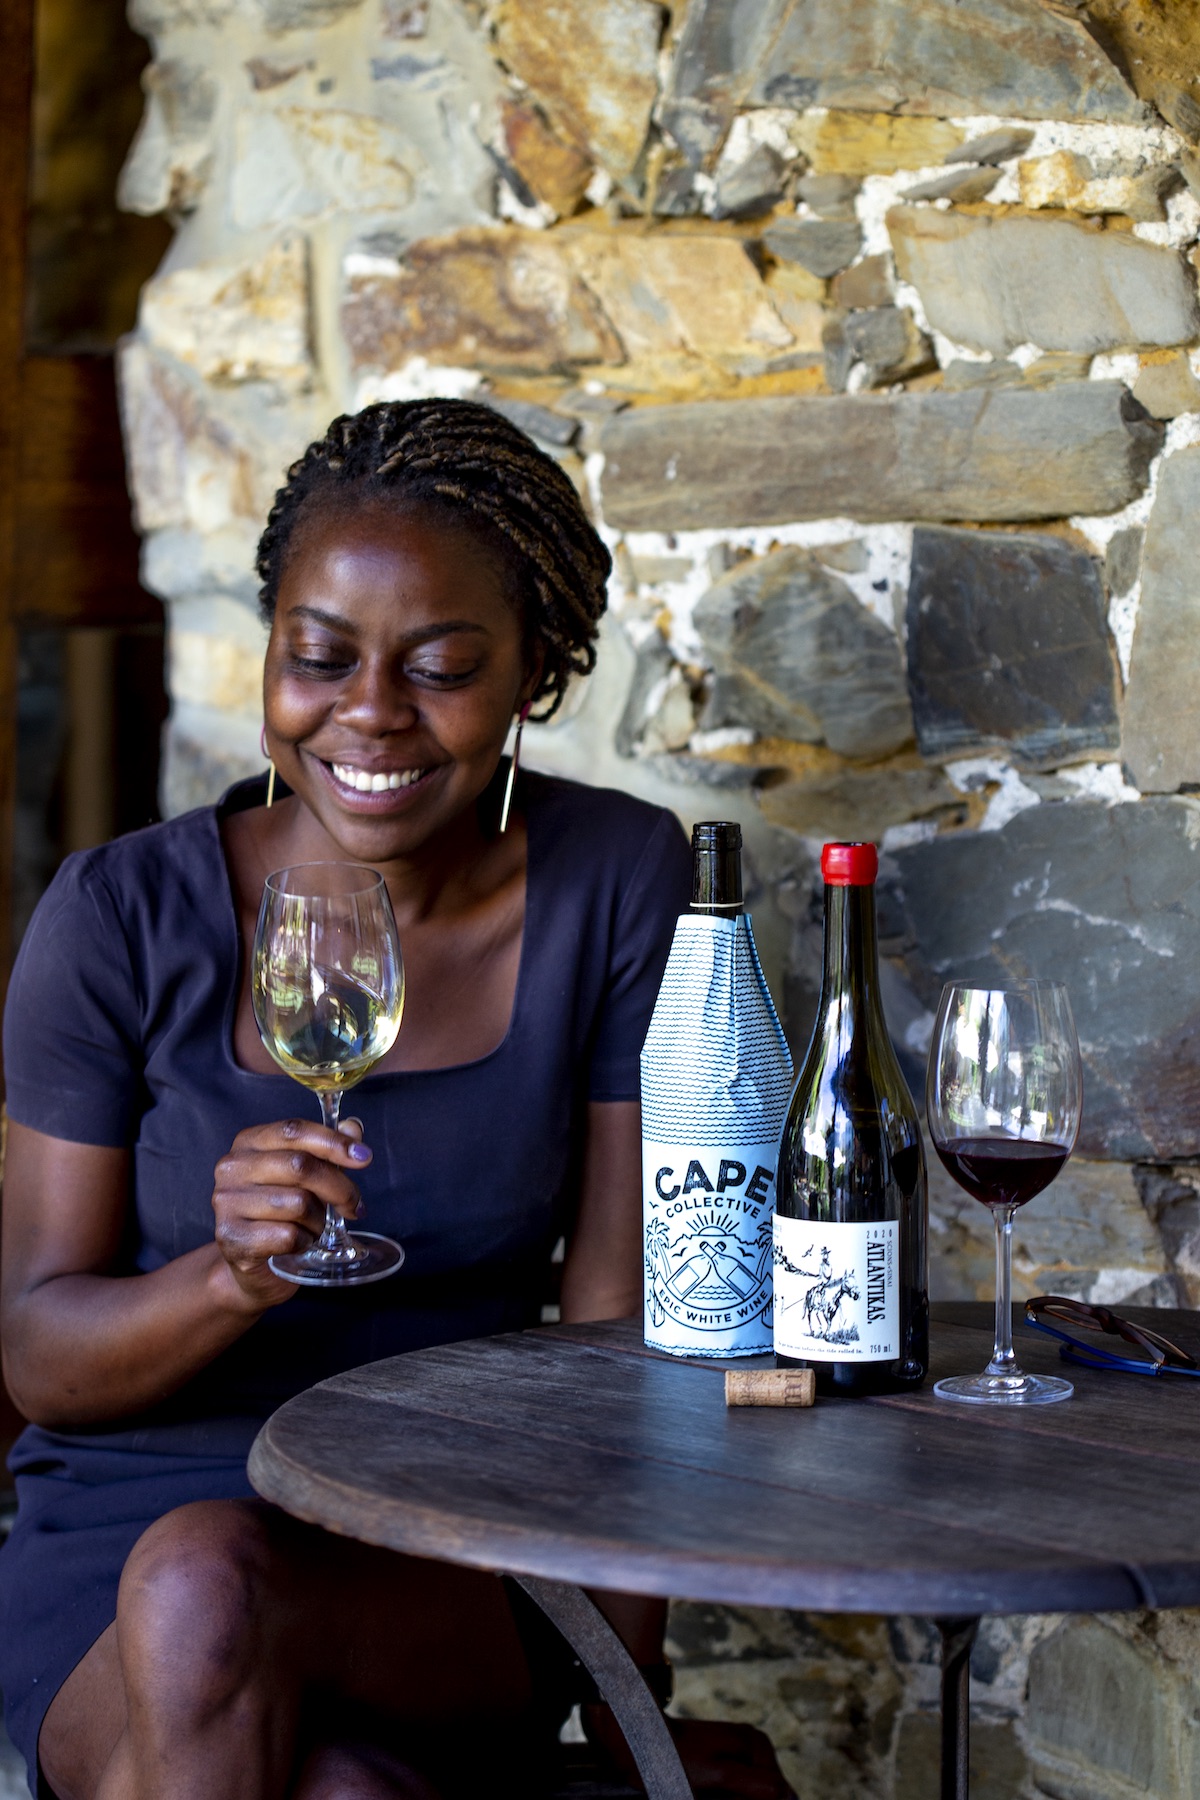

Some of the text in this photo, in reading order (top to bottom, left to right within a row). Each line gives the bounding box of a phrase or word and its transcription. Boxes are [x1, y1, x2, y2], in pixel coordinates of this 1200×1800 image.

[655, 1159, 774, 1205] CAPE
[666, 1197, 761, 1219] COLLECTIVE
[659, 1289, 768, 1323] EPIC WHITE WINE
[870, 1344, 881, 1354] 750
